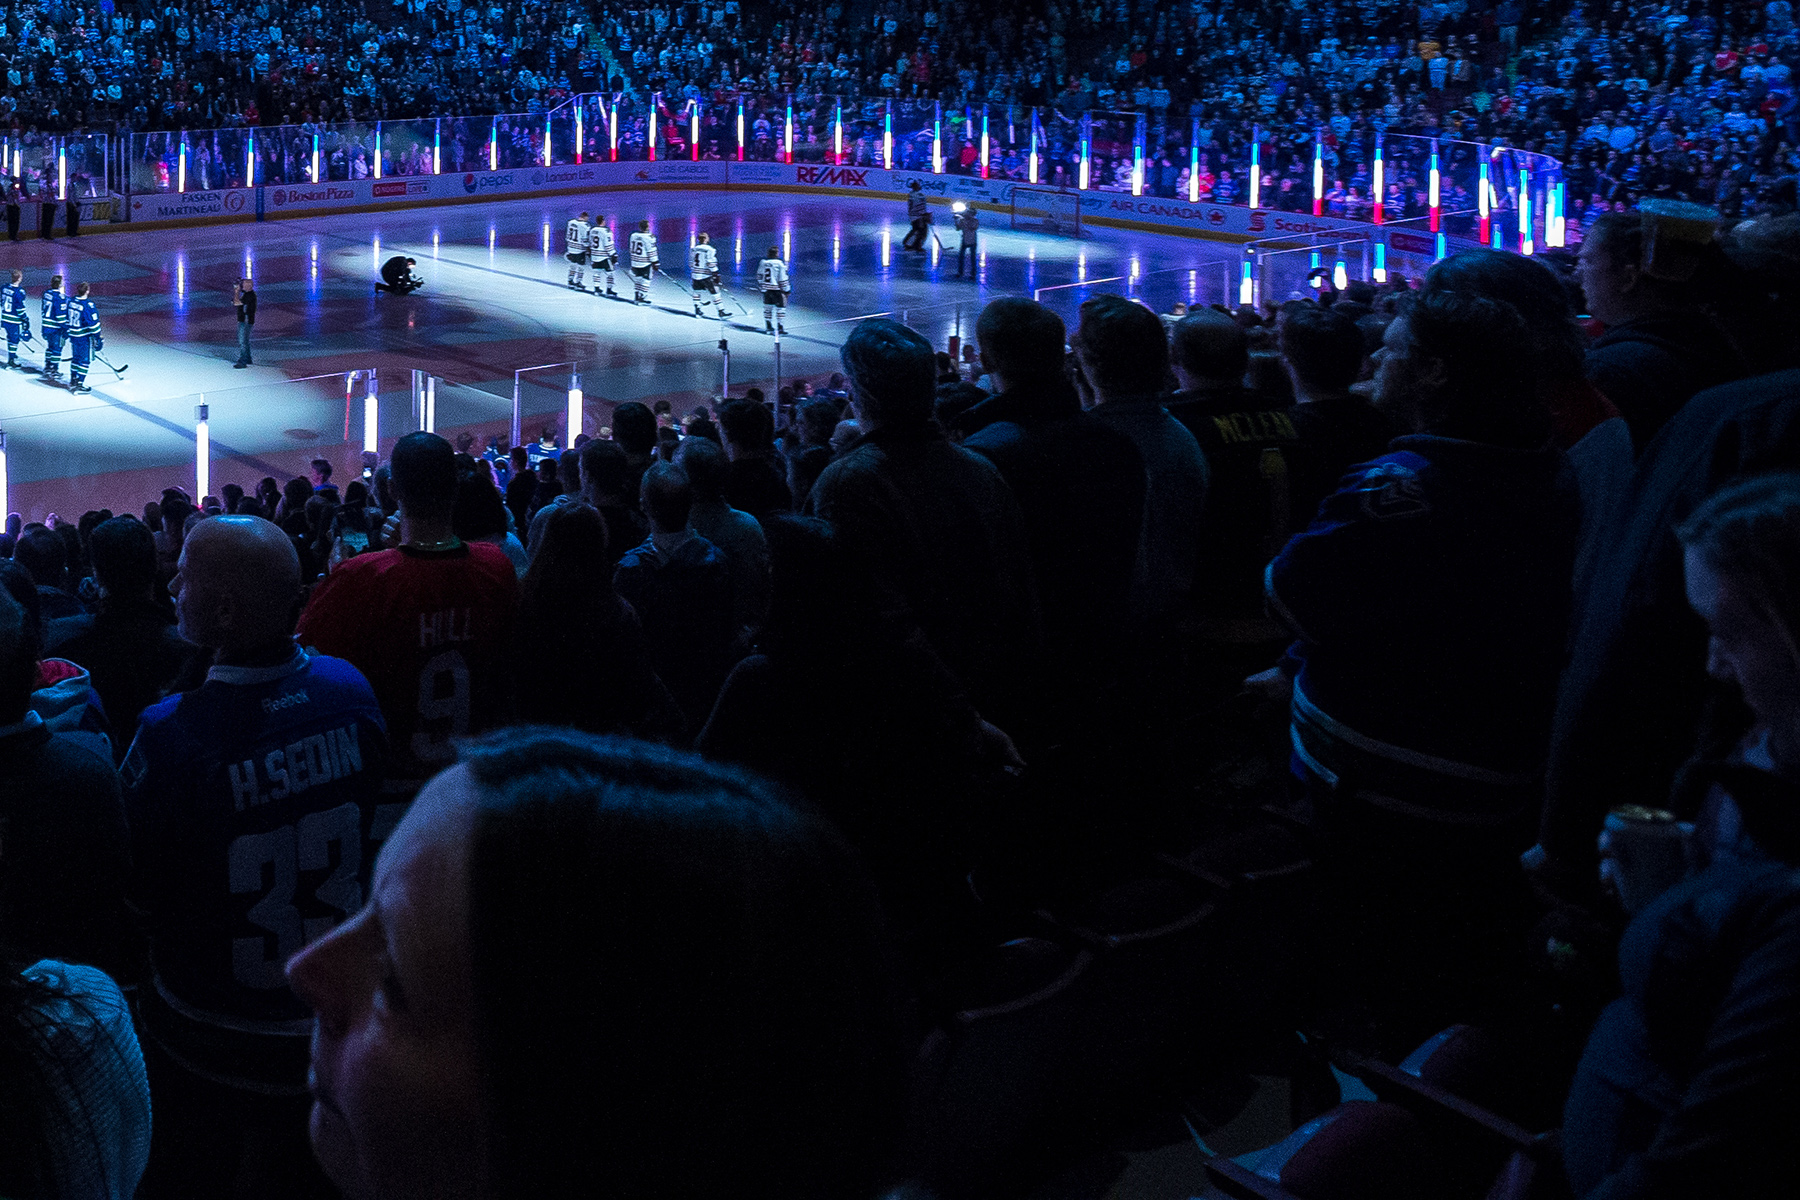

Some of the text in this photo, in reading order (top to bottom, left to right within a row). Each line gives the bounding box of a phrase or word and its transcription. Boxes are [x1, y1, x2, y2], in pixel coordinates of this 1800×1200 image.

[480, 171, 514, 190] pepsi
[546, 168, 595, 183] London Life
[797, 166, 869, 187] RE/MAX
[182, 192, 222, 203] FASKEN
[288, 187, 355, 203] Boston Pizza
[158, 203, 222, 216] MARTINEAU
[1110, 199, 1204, 221] AIR CANADA
[1259, 447, 1290, 558] 1
[260, 688, 311, 714] Reebok
[411, 649, 471, 762] 9
[229, 722, 363, 813] H.SEDIN
